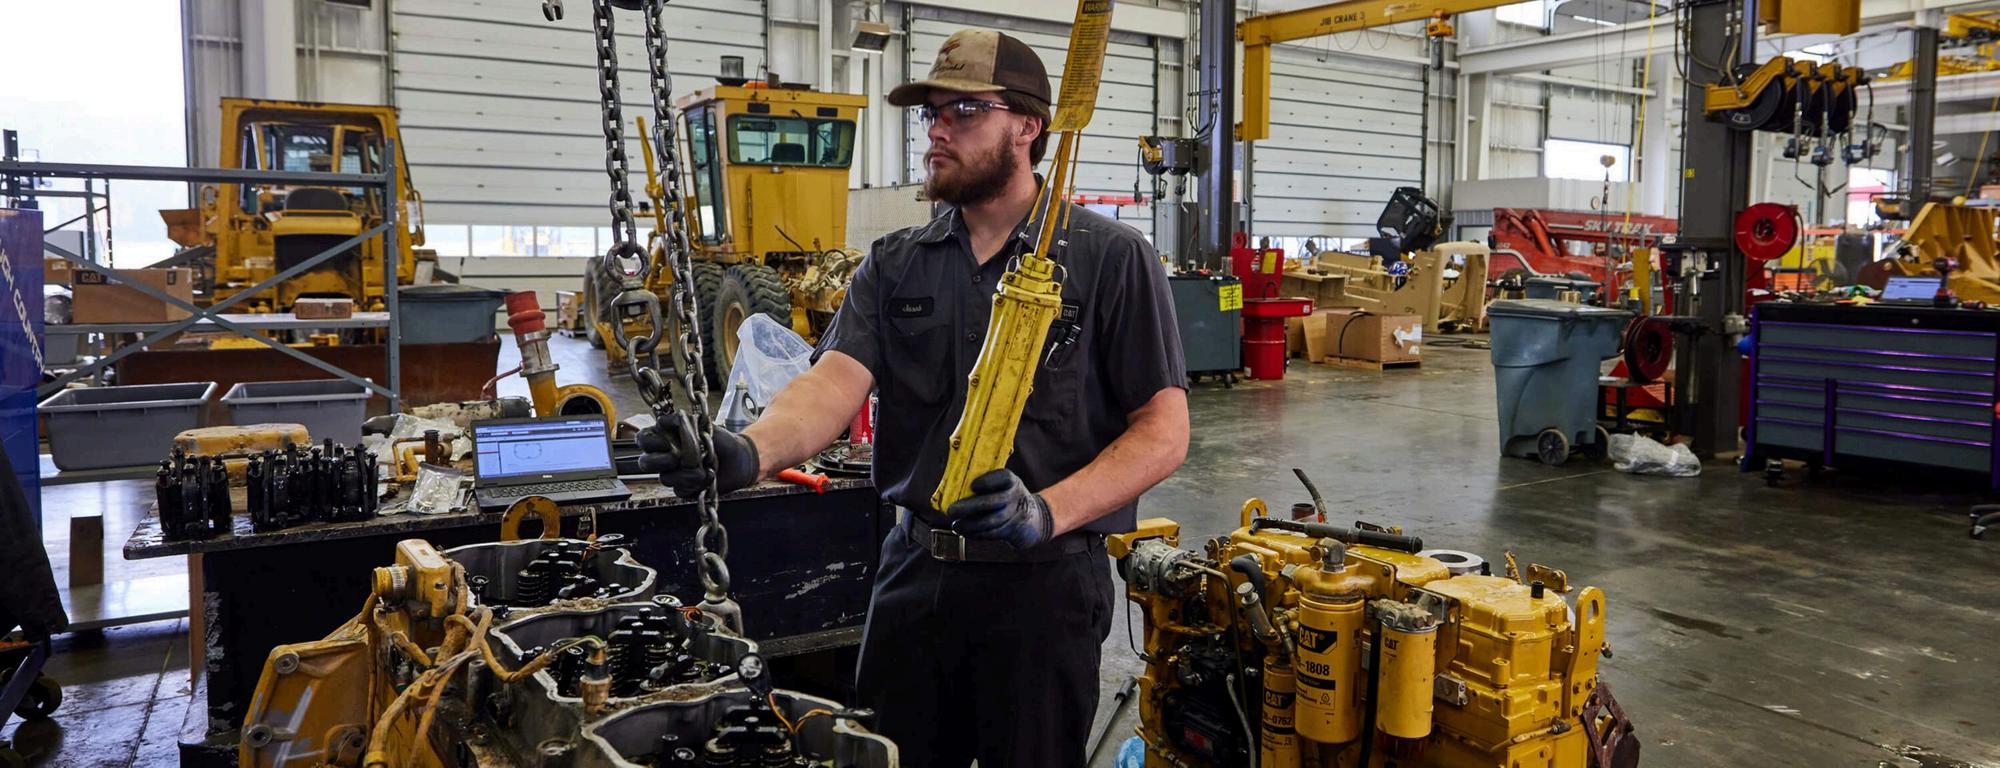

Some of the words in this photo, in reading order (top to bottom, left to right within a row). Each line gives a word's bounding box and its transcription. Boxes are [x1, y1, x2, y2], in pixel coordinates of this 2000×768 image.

[1320, 16, 1331, 26] JIB
[1334, 12, 1357, 24] CRANE
[1584, 219, 1612, 232] SKY
[1063, 309, 1076, 318] CAT
[1299, 625, 1319, 649] CAT
[1384, 636, 1399, 650] CAT
[1265, 690, 1283, 707] CAT
